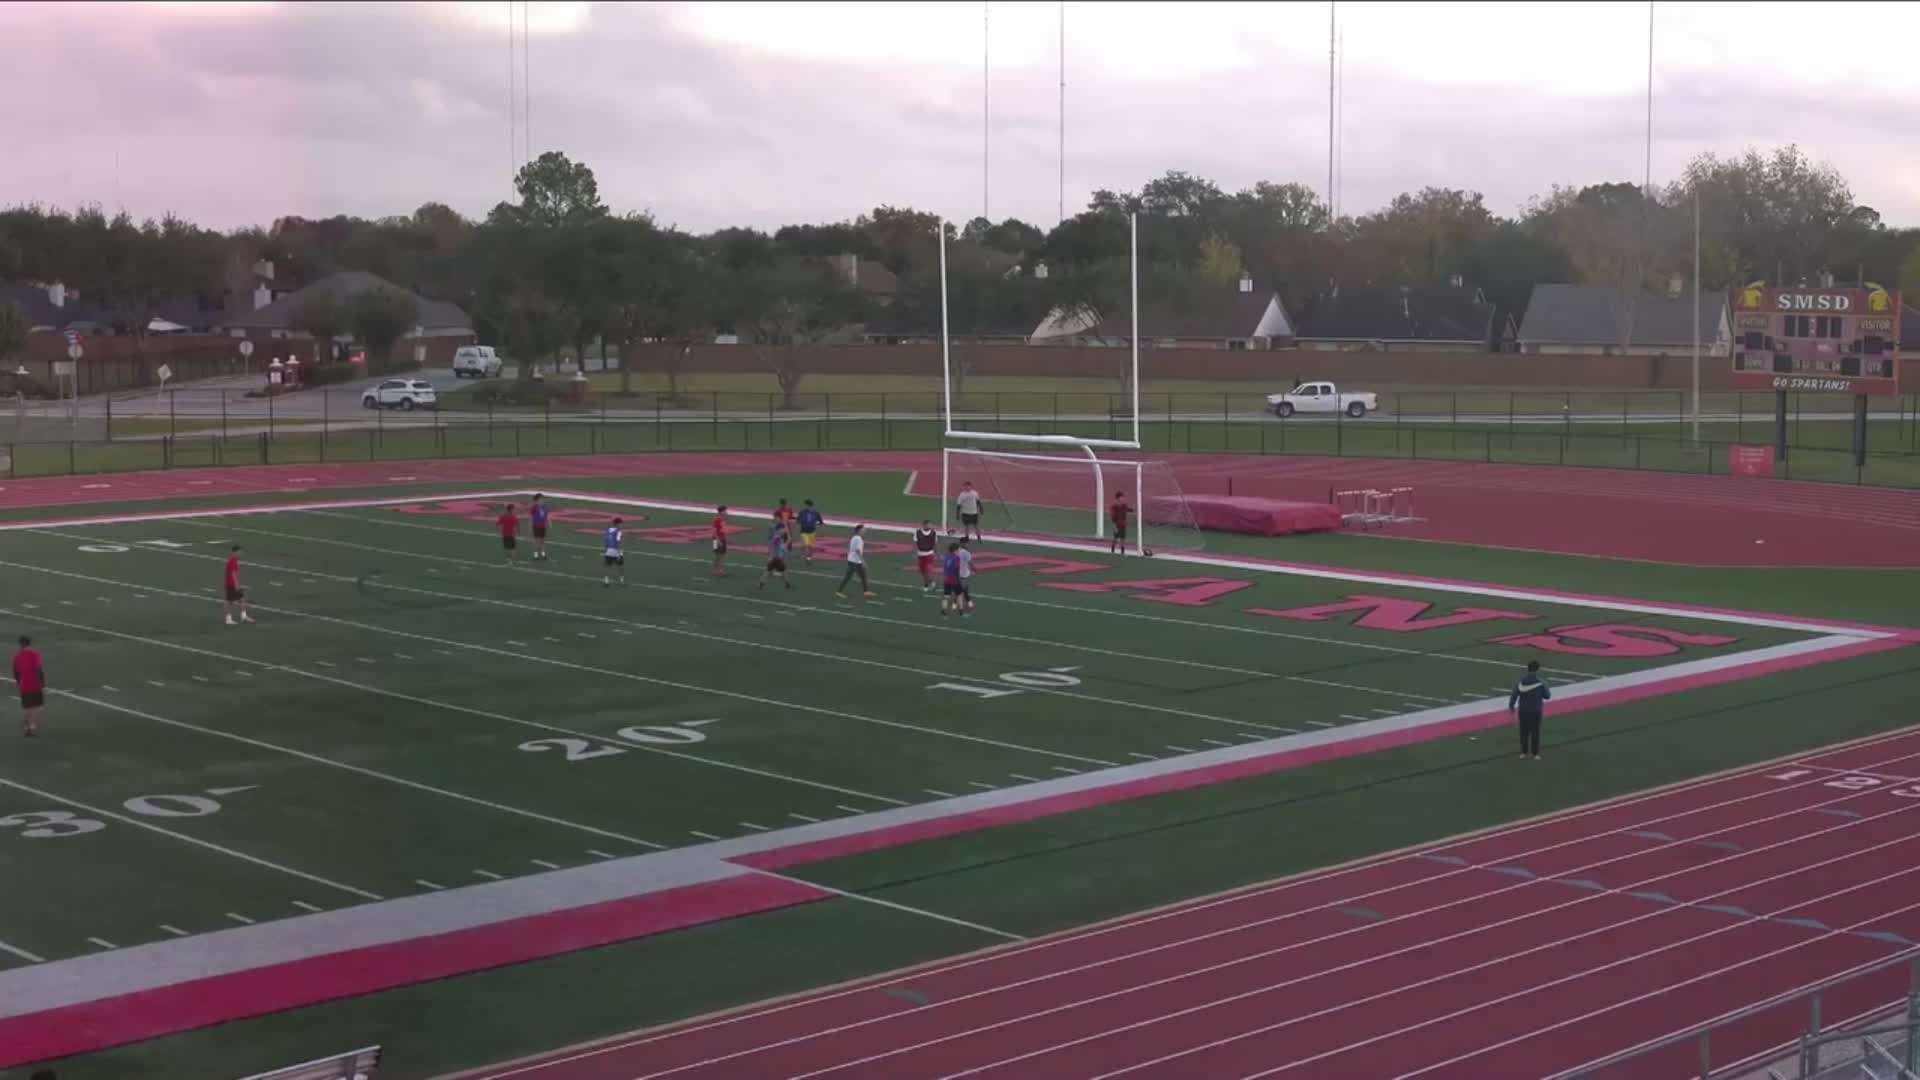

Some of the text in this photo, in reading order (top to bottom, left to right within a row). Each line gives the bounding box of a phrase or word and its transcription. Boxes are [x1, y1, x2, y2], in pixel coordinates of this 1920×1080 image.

[1778, 294, 1849, 310] SMSD
[1860, 319, 1891, 331] VISITOR
[1773, 377, 1850, 390] GO SPARTANS!
[924, 671, 1081, 698] 10
[517, 725, 707, 761] 20
[0, 794, 222, 837] 30
